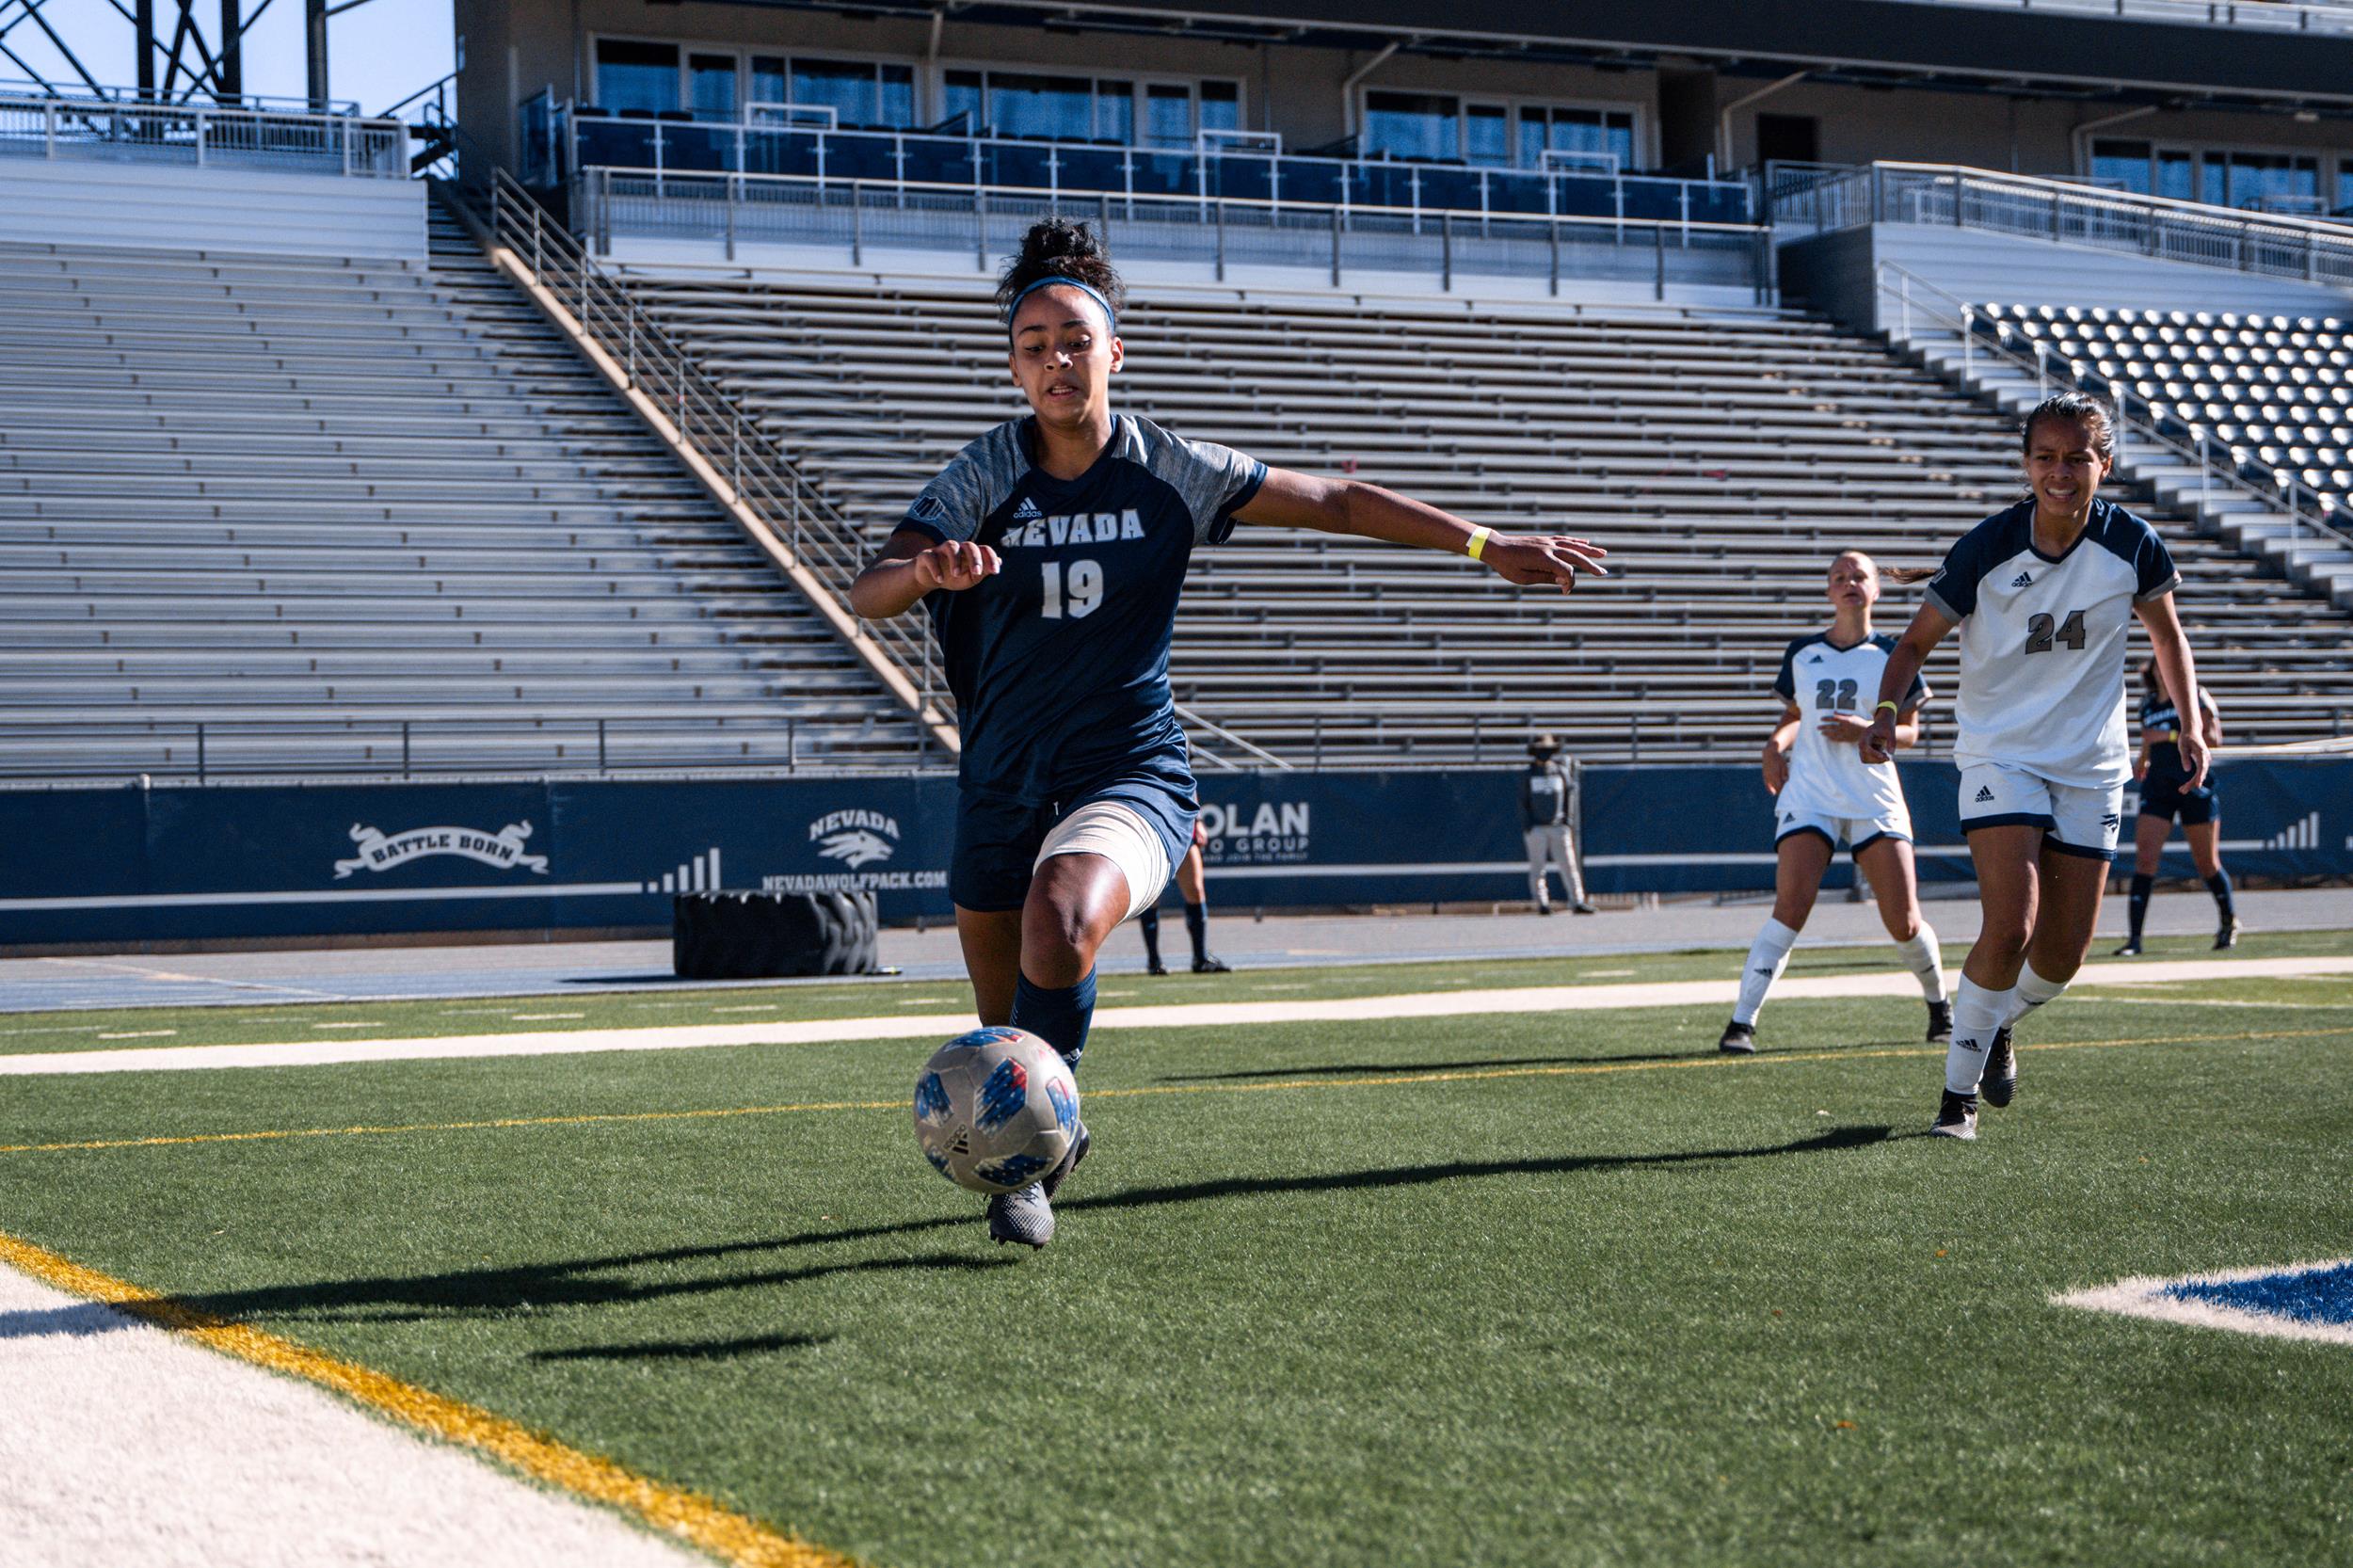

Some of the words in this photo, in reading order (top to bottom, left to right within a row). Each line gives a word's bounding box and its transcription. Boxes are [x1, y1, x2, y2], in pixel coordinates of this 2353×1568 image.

[1000, 508, 1145, 548] NEVADA
[1013, 510, 1043, 519] adidas
[1041, 559, 1104, 619] 19
[2025, 610, 2087, 655] 24
[1816, 679, 1858, 710] 22
[808, 809, 901, 841] NEVADA
[1200, 802, 1309, 838] OLAN
[371, 834, 451, 863] BATTLE
[458, 834, 515, 861] BORN
[1235, 836, 1309, 854] GROUP
[761, 870, 949, 891] NEVADAWOLFPACK.COM
